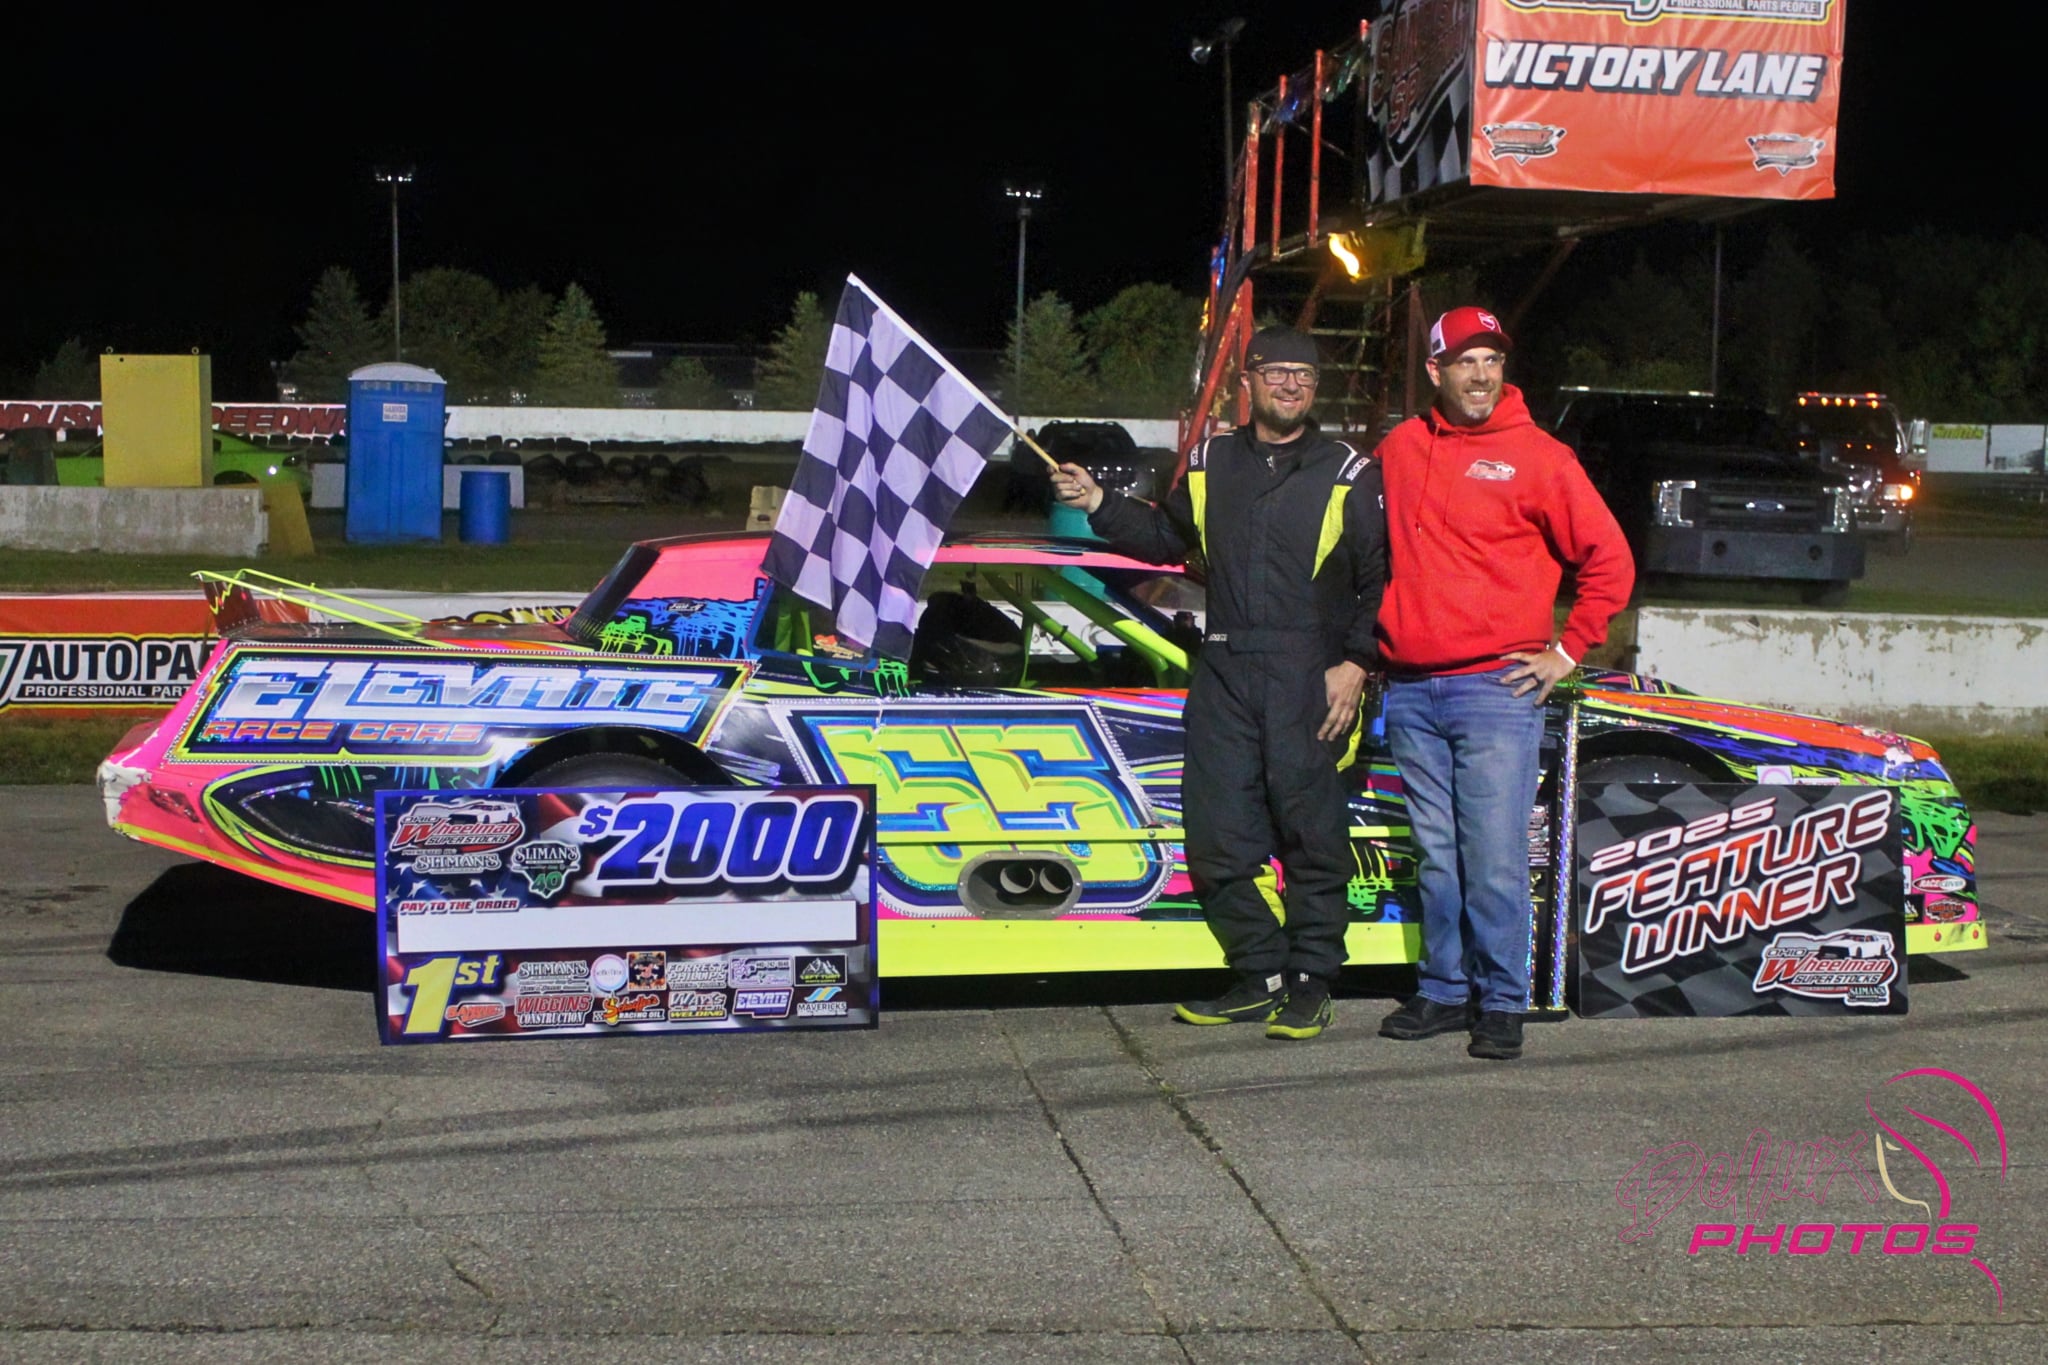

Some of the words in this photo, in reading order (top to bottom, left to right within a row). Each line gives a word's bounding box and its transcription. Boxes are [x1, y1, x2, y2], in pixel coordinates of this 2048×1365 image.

[1747, 0, 1777, 12] PARTS
[1781, 0, 1817, 14] PEOPLE
[1484, 41, 1699, 92] VICTORY
[1696, 50, 1824, 98] LANE
[22, 643, 134, 681] AUTO
[24, 685, 146, 697] PROFESSIONAL
[216, 660, 719, 728] ELEVATE
[203, 720, 339, 742] RACE
[349, 722, 488, 744] CARS
[396, 819, 519, 845] Wheelman
[428, 836, 464, 846] SUPER
[465, 834, 510, 845] STOCKS
[578, 800, 862, 882] $2000
[1590, 796, 1777, 872] 2025
[1585, 790, 1892, 934] FEATURE
[531, 871, 563, 891] 40
[400, 902, 425, 913] PAY
[431, 902, 446, 911] TO
[449, 901, 472, 911] THE
[476, 900, 518, 910] ORDER
[1621, 852, 1860, 973] WINNER
[1767, 948, 1807, 957] OHIO
[668, 961, 727, 973] FORREST
[1759, 951, 1891, 984] Wheelman
[668, 971, 727, 982] PHILLIPS
[1793, 973, 1831, 984] SUPER
[1833, 973, 1881, 984] STOCKS
[403, 954, 499, 1035] 1st
[517, 996, 590, 1013] WIGGINS
[798, 1002, 846, 1011] MAVERICKS
[518, 1011, 584, 1026] CONSTRUCTION
[670, 1010, 725, 1018] WELDING
